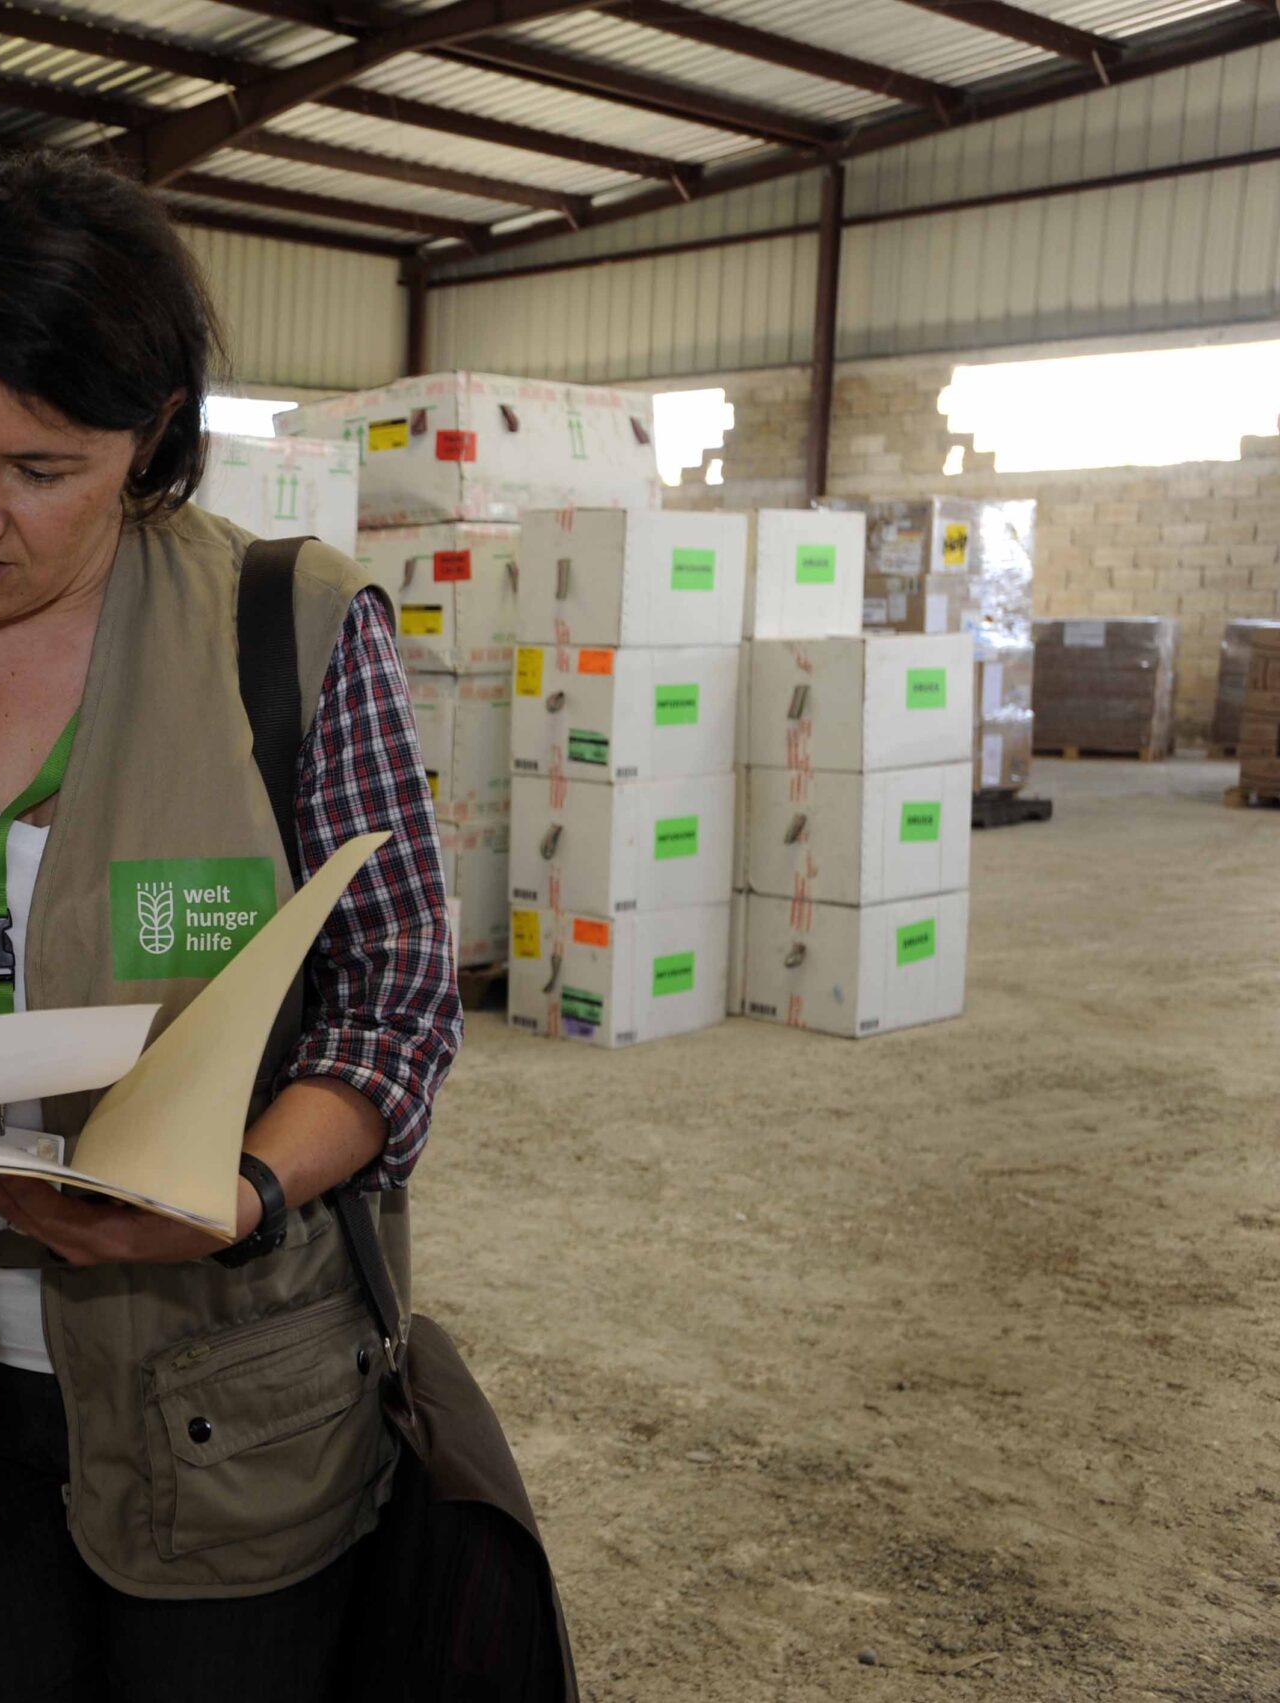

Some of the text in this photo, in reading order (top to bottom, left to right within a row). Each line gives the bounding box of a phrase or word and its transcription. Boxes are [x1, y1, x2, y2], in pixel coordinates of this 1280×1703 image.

[183, 885, 231, 903] welt
[186, 908, 258, 930] hunger
[186, 932, 232, 951] hilfe
